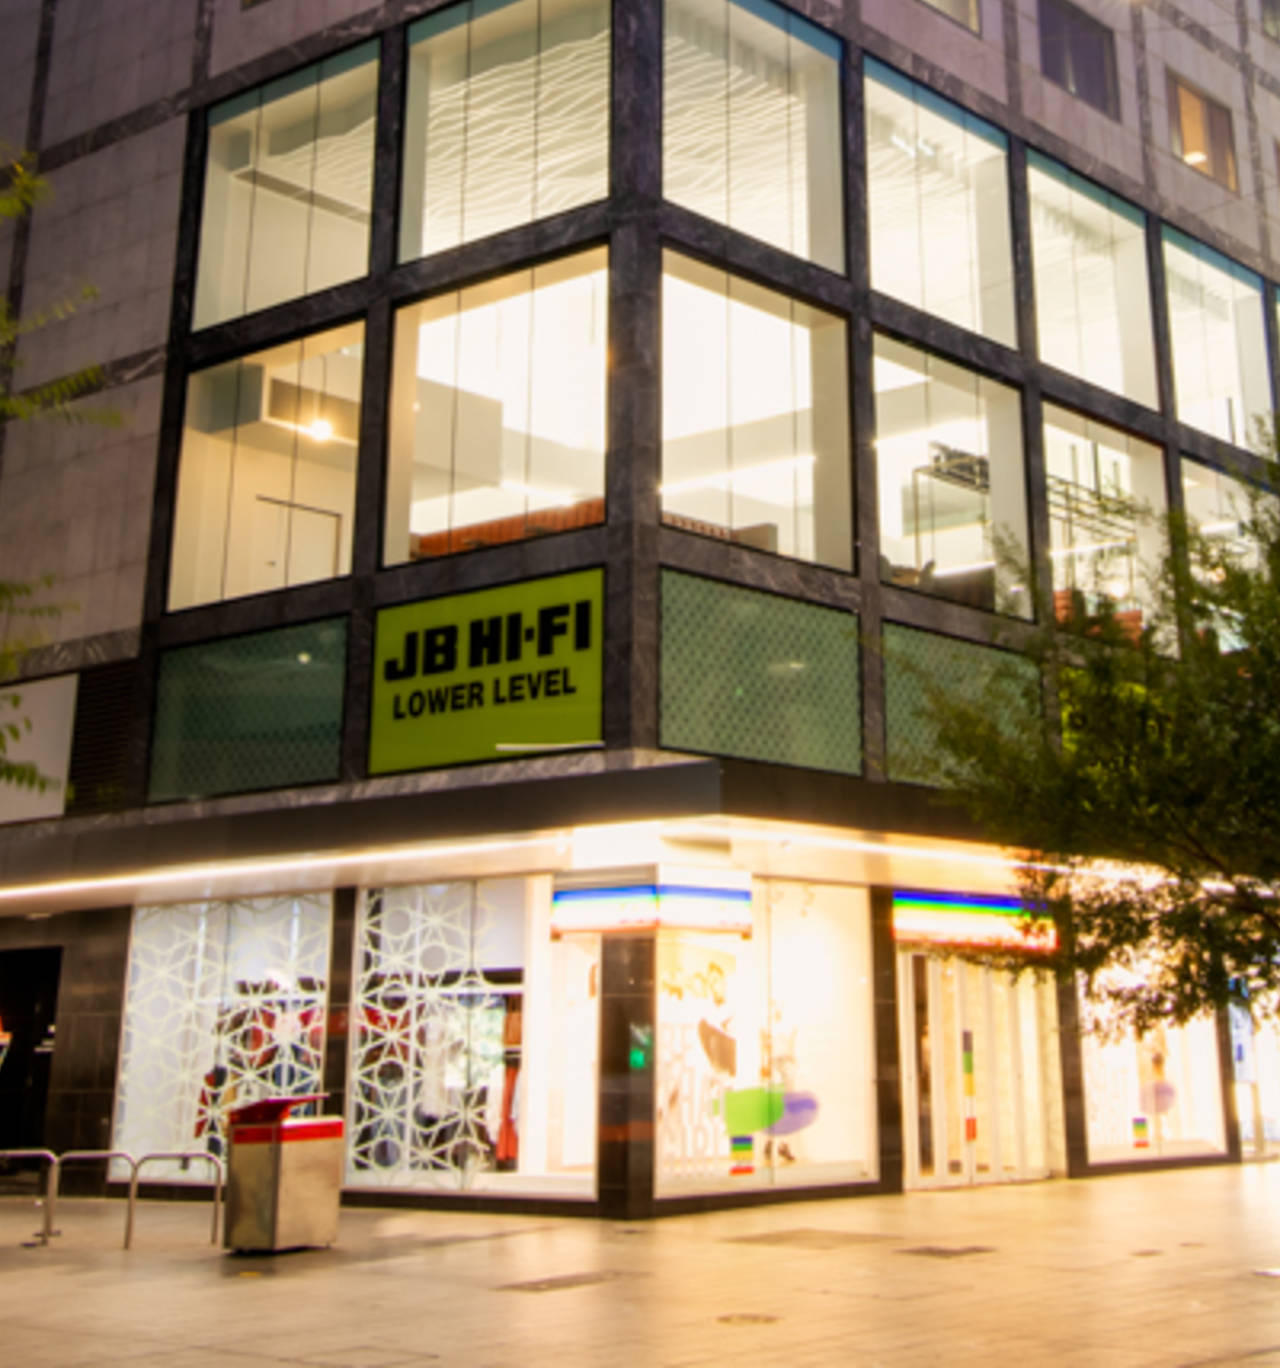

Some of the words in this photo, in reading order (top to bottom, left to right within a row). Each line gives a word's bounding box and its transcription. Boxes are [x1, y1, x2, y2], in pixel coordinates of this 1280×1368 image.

[384, 625, 458, 681] JB
[393, 682, 484, 720] LOWER
[493, 667, 577, 705] LEVEL
